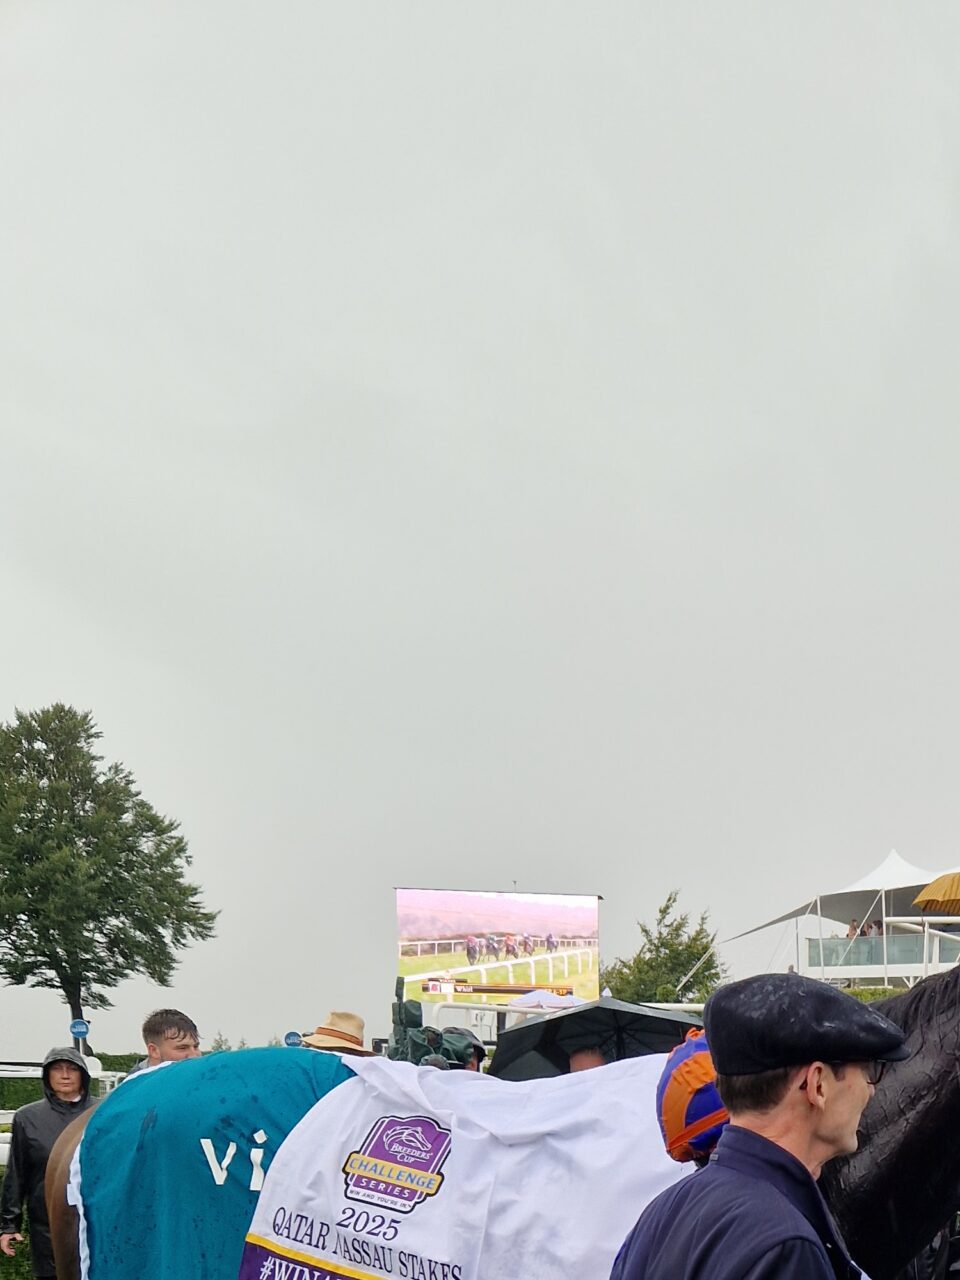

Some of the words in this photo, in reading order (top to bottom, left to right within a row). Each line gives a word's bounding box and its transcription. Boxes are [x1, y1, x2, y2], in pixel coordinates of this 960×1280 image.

[349, 1158, 436, 1190] CHALLENGE
[359, 1178, 412, 1198] SERIES
[272, 1206, 330, 1251] QATAR
[332, 1230, 393, 1274] NASSAU
[336, 1207, 402, 1241] 2025
